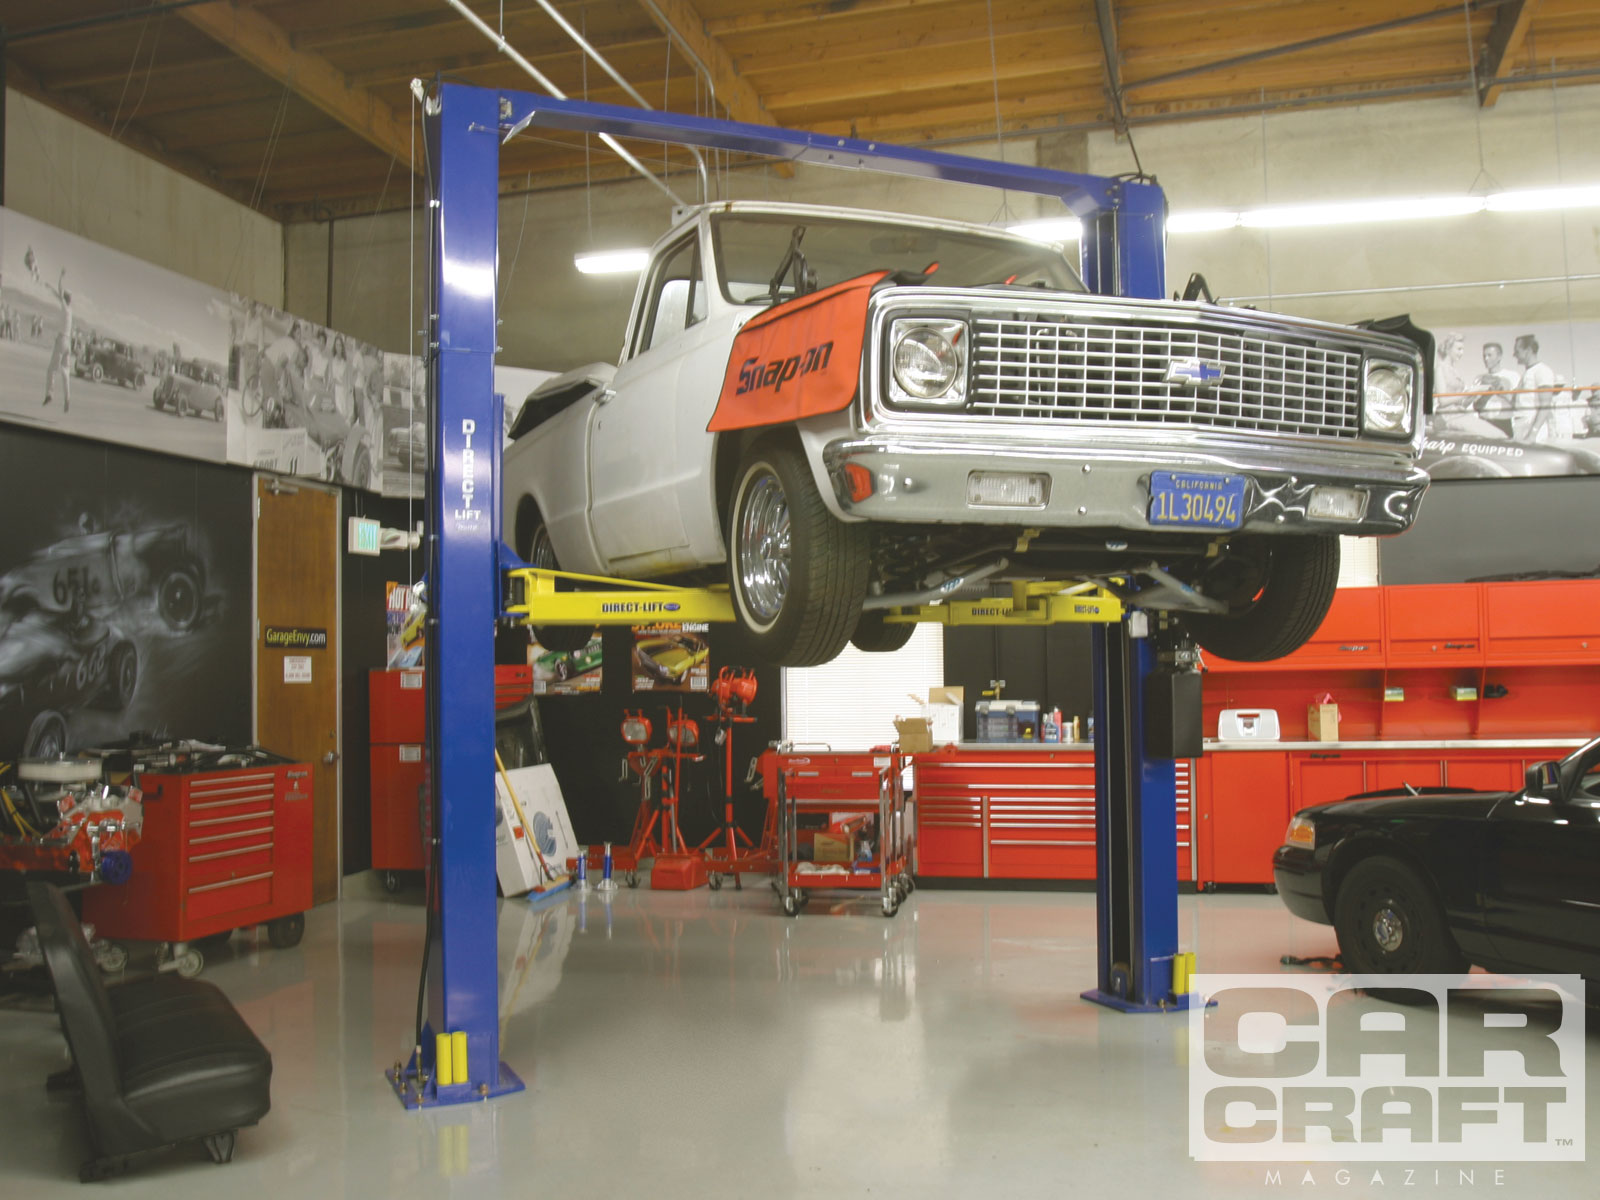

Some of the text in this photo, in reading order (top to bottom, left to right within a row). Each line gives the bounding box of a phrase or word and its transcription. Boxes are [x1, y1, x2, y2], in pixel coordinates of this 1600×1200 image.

[736, 340, 834, 395] Snap-on
[1461, 443, 1524, 457] EQUIPPED
[462, 418, 476, 509] DIRECT
[1175, 479, 1223, 490] CALIFORNIA
[454, 509, 481, 520] LIFT
[1157, 492, 1237, 523] 1L30494
[358, 522, 378, 550] EXIT
[388, 586, 406, 609] HOT
[602, 602, 663, 613] DIRECT-LIFT
[682, 622, 709, 633] ENGINE
[266, 628, 326, 647] GarageEnvy.com
